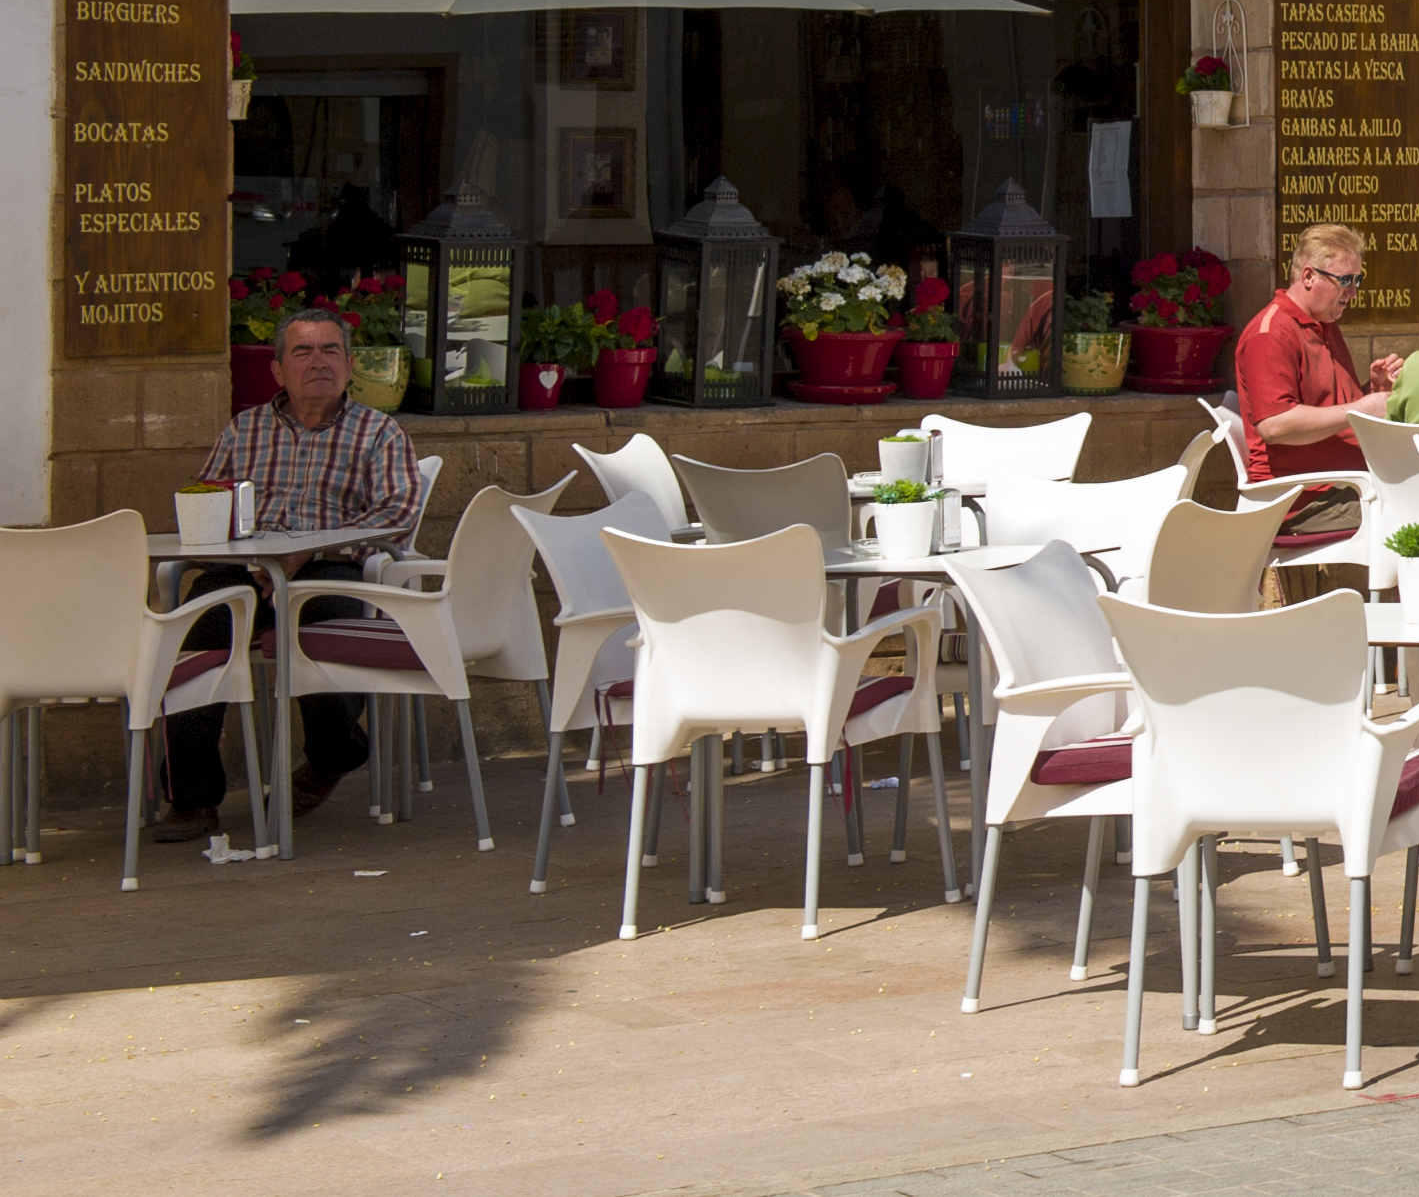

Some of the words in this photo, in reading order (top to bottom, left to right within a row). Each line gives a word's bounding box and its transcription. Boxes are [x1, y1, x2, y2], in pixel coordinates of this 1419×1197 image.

[76, 0, 180, 25] BURGUERS
[1280, 2, 1324, 22] TAPAS
[1326, 3, 1385, 24] CASERAS
[1281, 31, 1339, 51] PESCADO
[1341, 32, 1358, 51] DE
[1360, 32, 1377, 51] LA
[1380, 32, 1419, 52] BAHIA
[75, 59, 201, 83] SANDWICHES
[1281, 60, 1342, 80] PATATAS
[1344, 61, 1362, 80] LA
[1364, 58, 1405, 81] YESCA
[1281, 86, 1334, 109] BRAVAS
[73, 122, 169, 143] BOCATAS
[1281, 117, 1336, 137] GAMBAS
[1338, 118, 1357, 137] AL
[1359, 118, 1402, 137] AJILLO
[1281, 146, 1360, 166] CALAMARES
[1362, 146, 1373, 166] A
[1375, 146, 1393, 166] LA
[74, 181, 152, 203] PLATOS
[1281, 175, 1325, 195] JAMON
[1326, 172, 1338, 194] Y
[1338, 175, 1379, 196] QUESO
[80, 211, 201, 233] ESPECIALES
[1282, 203, 1368, 224] ENSALADILLA
[1386, 232, 1418, 252] ESCA
[74, 271, 91, 295] Y
[94, 270, 216, 294] AUTENTICOS
[1368, 288, 1412, 309] TAPAS
[80, 302, 164, 324] MOJITOS
